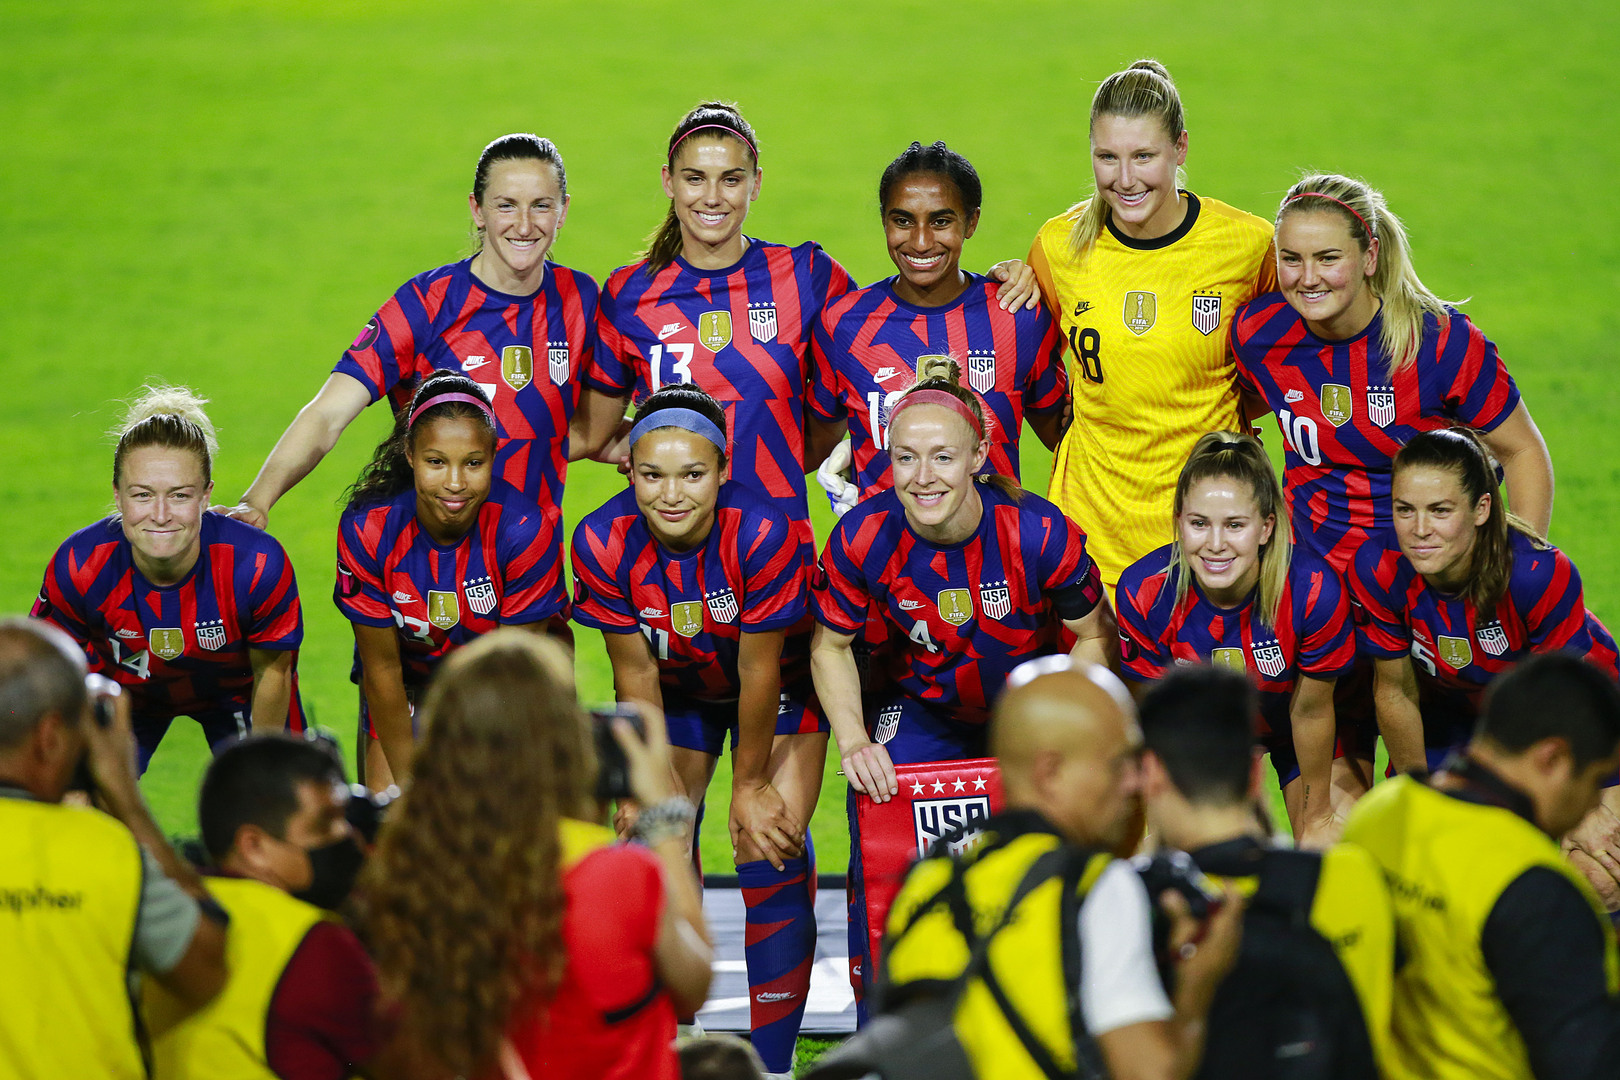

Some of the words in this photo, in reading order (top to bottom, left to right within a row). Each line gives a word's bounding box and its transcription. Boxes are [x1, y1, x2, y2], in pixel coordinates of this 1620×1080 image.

[1194, 298, 1218, 313] USA
[750, 310, 775, 324] USA
[662, 322, 681, 333] NIKE
[465, 355, 486, 365] NIKE
[550, 351, 568, 365] USA
[1069, 326, 1104, 384] 18
[649, 343, 695, 394] 13
[877, 367, 896, 377] NIKE
[969, 358, 993, 373] USA
[1369, 393, 1393, 408] USA
[1279, 409, 1321, 466] 10
[394, 590, 411, 600] NIKE
[468, 584, 492, 599] USA
[983, 589, 1007, 603] USA
[710, 593, 734, 609] USA
[901, 599, 919, 607] NIKE
[643, 606, 663, 616] NIKE
[119, 628, 138, 636] NIKE
[199, 627, 223, 638] USA
[909, 619, 939, 654] 4
[1477, 627, 1502, 641] USA
[108, 637, 151, 680] 14
[1255, 647, 1281, 661] USA
[1411, 640, 1436, 677] 5
[879, 712, 899, 727] USA
[919, 803, 987, 843] USA
